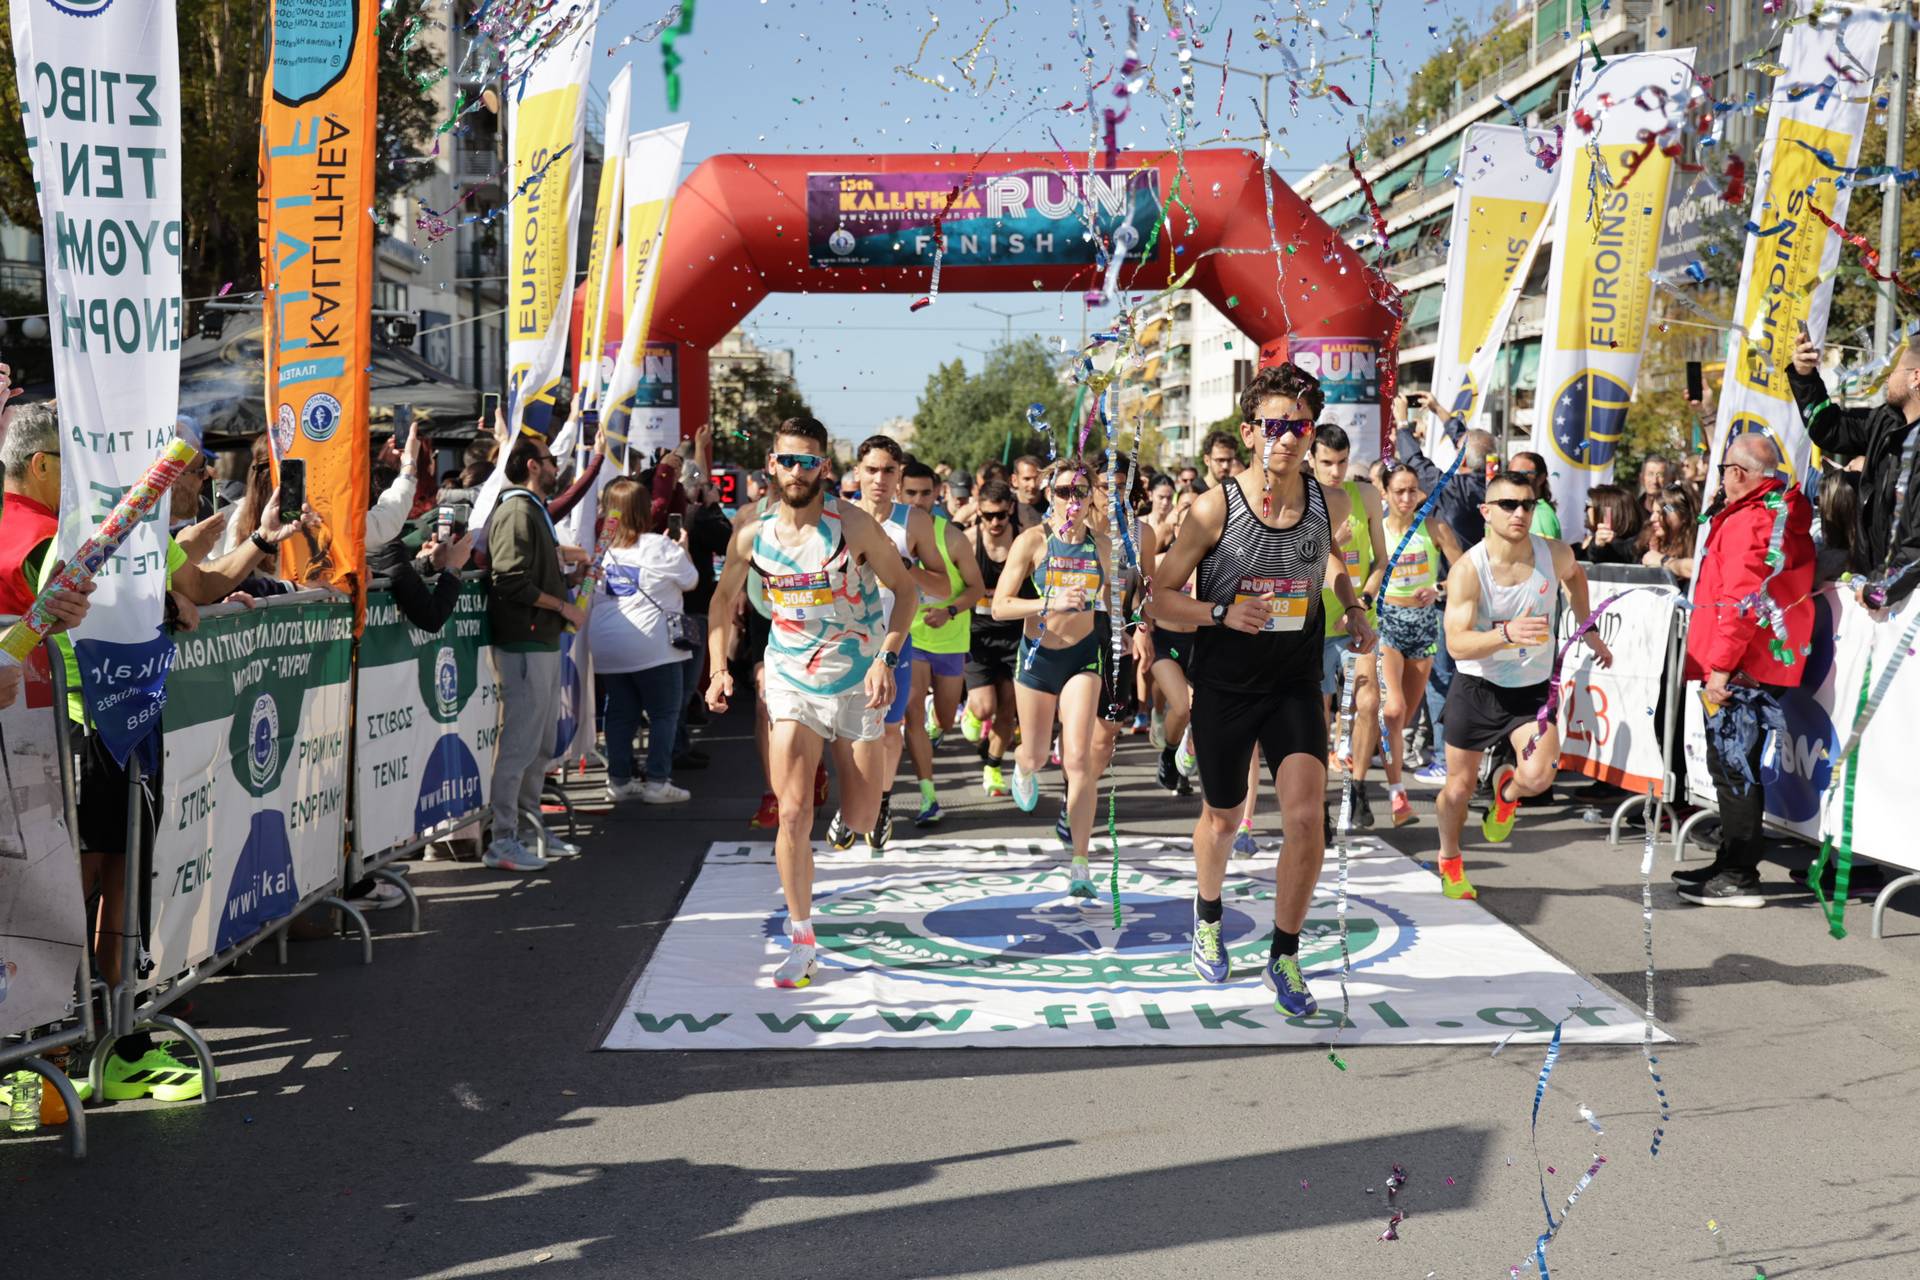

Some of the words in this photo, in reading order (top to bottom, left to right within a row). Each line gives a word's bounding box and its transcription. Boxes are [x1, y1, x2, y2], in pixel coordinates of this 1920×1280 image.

[839, 190, 982, 212] KALLITHEA
[986, 173, 1127, 220] RUN
[519, 147, 548, 334] EUROINS
[915, 233, 1054, 255] FINISH
[1590, 191, 1629, 347] EUROINS
[1748, 189, 1804, 387] EUROINS
[1294, 351, 1376, 380] RUN
[783, 591, 814, 605] 5045
[1240, 578, 1275, 593] RUN
[277, 652, 313, 679] ΤΑΥΡΟΥ
[367, 706, 413, 740] ΣΤΙΒΟΣ
[298, 735, 342, 769] ΡΥΘΜΙΚΗ
[373, 755, 409, 789] ΤΕΝΙΣ
[633, 1000, 1618, 1034] www.filkal.gr
